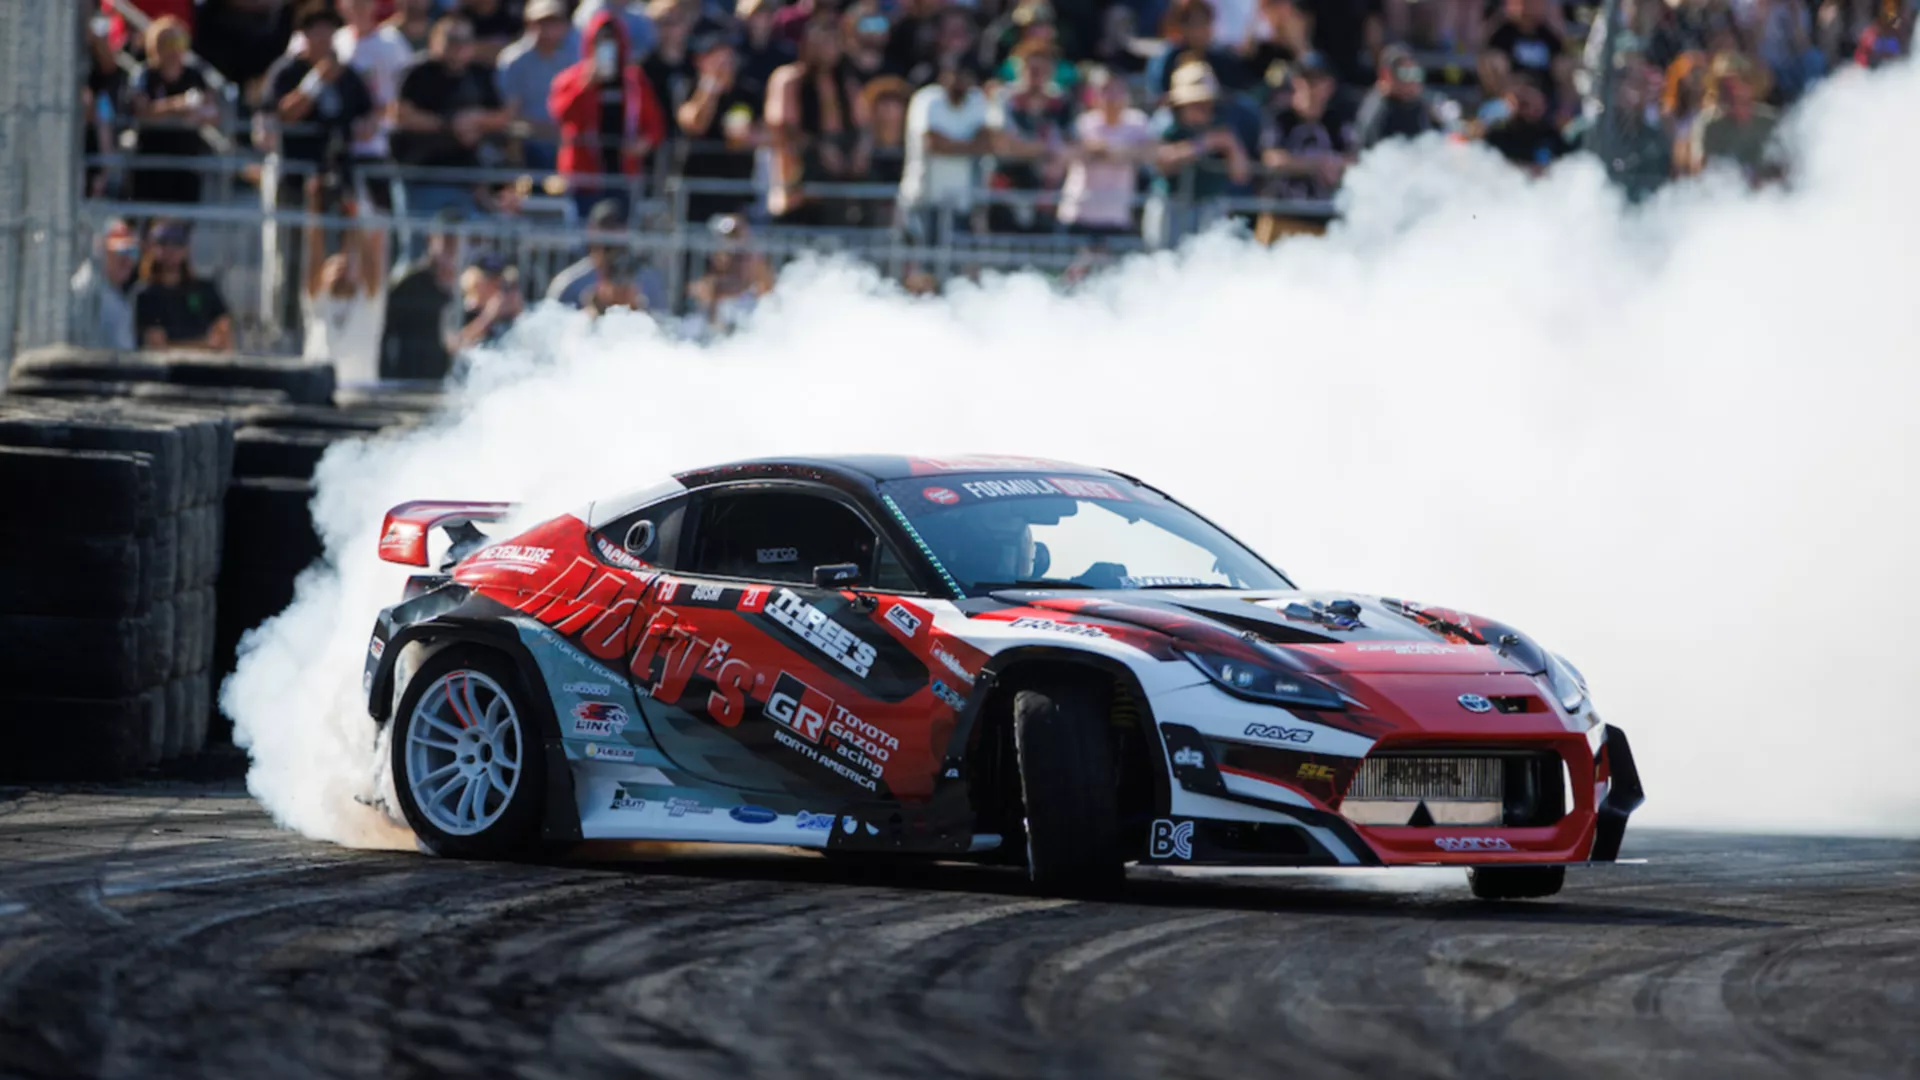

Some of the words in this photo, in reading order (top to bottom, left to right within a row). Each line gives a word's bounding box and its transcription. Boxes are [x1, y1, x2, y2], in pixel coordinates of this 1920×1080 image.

[961, 478, 1061, 498] FORMULA
[770, 606, 863, 674] RACING
[774, 587, 877, 668] THREE'S
[767, 692, 824, 740] GR
[836, 704, 900, 751] TOYOTA
[1244, 722, 1314, 743] RAYS
[773, 729, 818, 760] NORTH
[818, 754, 877, 792] AMERICA
[823, 734, 884, 778] Racing
[828, 720, 890, 762] GAZOO
[1150, 819, 1195, 860] BC
